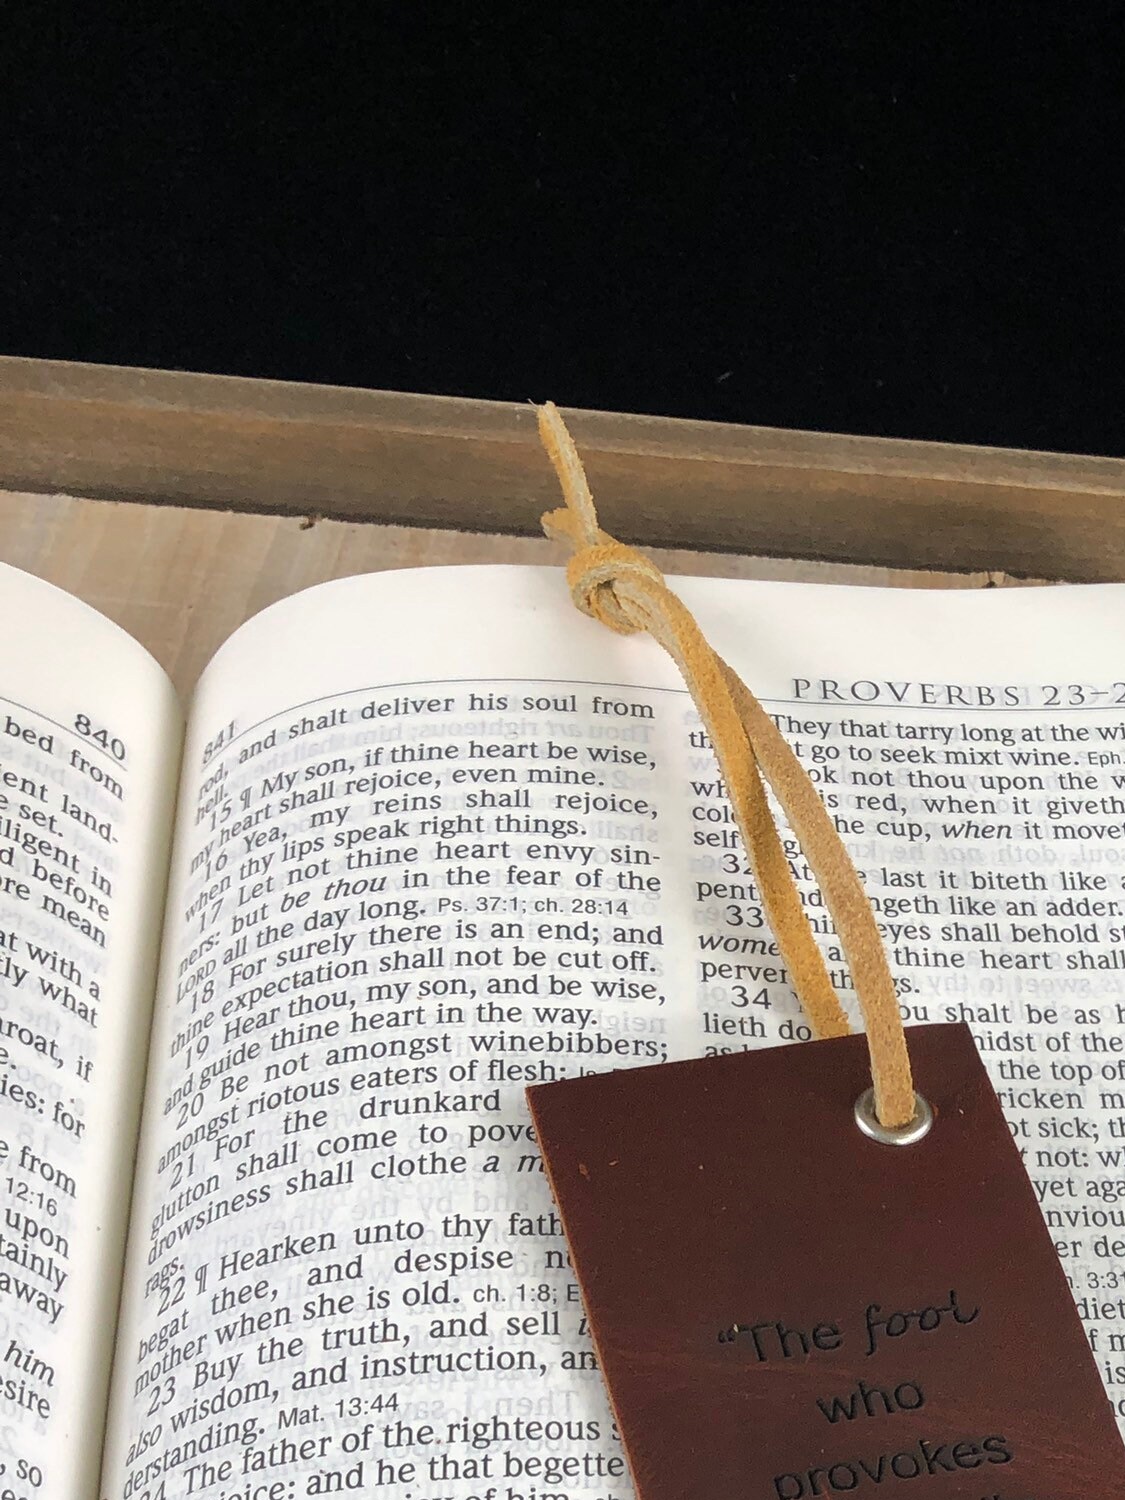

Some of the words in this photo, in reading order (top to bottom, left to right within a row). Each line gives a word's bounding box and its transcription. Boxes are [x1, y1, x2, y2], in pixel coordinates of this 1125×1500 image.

[360, 697, 455, 720] deliver
[468, 693, 508, 711] his
[522, 694, 578, 713] soul
[591, 696, 656, 719] from
[792, 678, 1020, 707] PROVERBS
[74, 712, 126, 762] 840
[838, 718, 890, 739] that
[894, 722, 955, 746] tarry
[960, 723, 1017, 747] long
[1021, 725, 1045, 743] at
[1049, 723, 1090, 742] the
[3, 715, 54, 755] bed
[68, 748, 125, 802] from
[363, 746, 385, 768] if
[390, 744, 459, 764] thine
[467, 740, 540, 759] heart
[546, 740, 579, 761] be
[586, 747, 656, 771] wise,
[943, 747, 1001, 768] mixt
[1010, 748, 1081, 768] wine.
[18, 803, 64, 838] set.
[372, 794, 442, 816] reins
[465, 788, 532, 809] shall
[555, 791, 658, 820] rejoice,
[333, 818, 410, 851] speak
[418, 814, 486, 840] right
[494, 813, 587, 840] things.
[876, 820, 932, 843] cup,
[941, 819, 1013, 840] when
[1023, 822, 1044, 840] it
[31, 858, 110, 923] before
[880, 866, 928, 889] last
[938, 869, 960, 890] it
[969, 870, 1049, 891] biteth
[1059, 871, 1107, 891] like
[40, 894, 106, 948] mean
[358, 899, 427, 922] long.
[438, 897, 470, 913] Ps.
[475, 896, 527, 912] 37:1;
[534, 897, 565, 913] ch.
[571, 898, 629, 916] 28:14
[25, 940, 84, 988] with
[379, 946, 445, 973] shall
[454, 947, 504, 967] not
[512, 945, 547, 967] be
[557, 950, 604, 970] cut
[611, 950, 657, 973] off.
[37, 975, 100, 1030] what
[325, 1032, 453, 1067] amongst
[468, 1032, 668, 1064] winebibbers;
[1045, 1031, 1071, 1053] of
[1080, 1031, 1124, 1053] the
[52, 1100, 87, 1140] for
[359, 1088, 502, 1120] drunkard
[1037, 1116, 1100, 1144] sick;
[4, 1175, 59, 1218] 12:16
[1031, 1176, 1078, 1203] yet
[4, 1206, 71, 1261] upon
[218, 1232, 337, 1282] Hearken
[352, 1219, 425, 1246] unto
[441, 1213, 494, 1244] thy
[302, 1292, 355, 1321] she
[365, 1285, 391, 1311] is
[402, 1279, 461, 1307] old.
[472, 1284, 507, 1303] ch.
[515, 1283, 560, 1305] 1:8;
[863, 1288, 981, 1358] fool
[3, 1338, 56, 1388] him
[360, 1347, 547, 1381] instruction,
[277, 1404, 326, 1430] Mat.
[335, 1392, 399, 1419] 13:44
[815, 1379, 926, 1424] who
[446, 1415, 601, 1449] righteous
